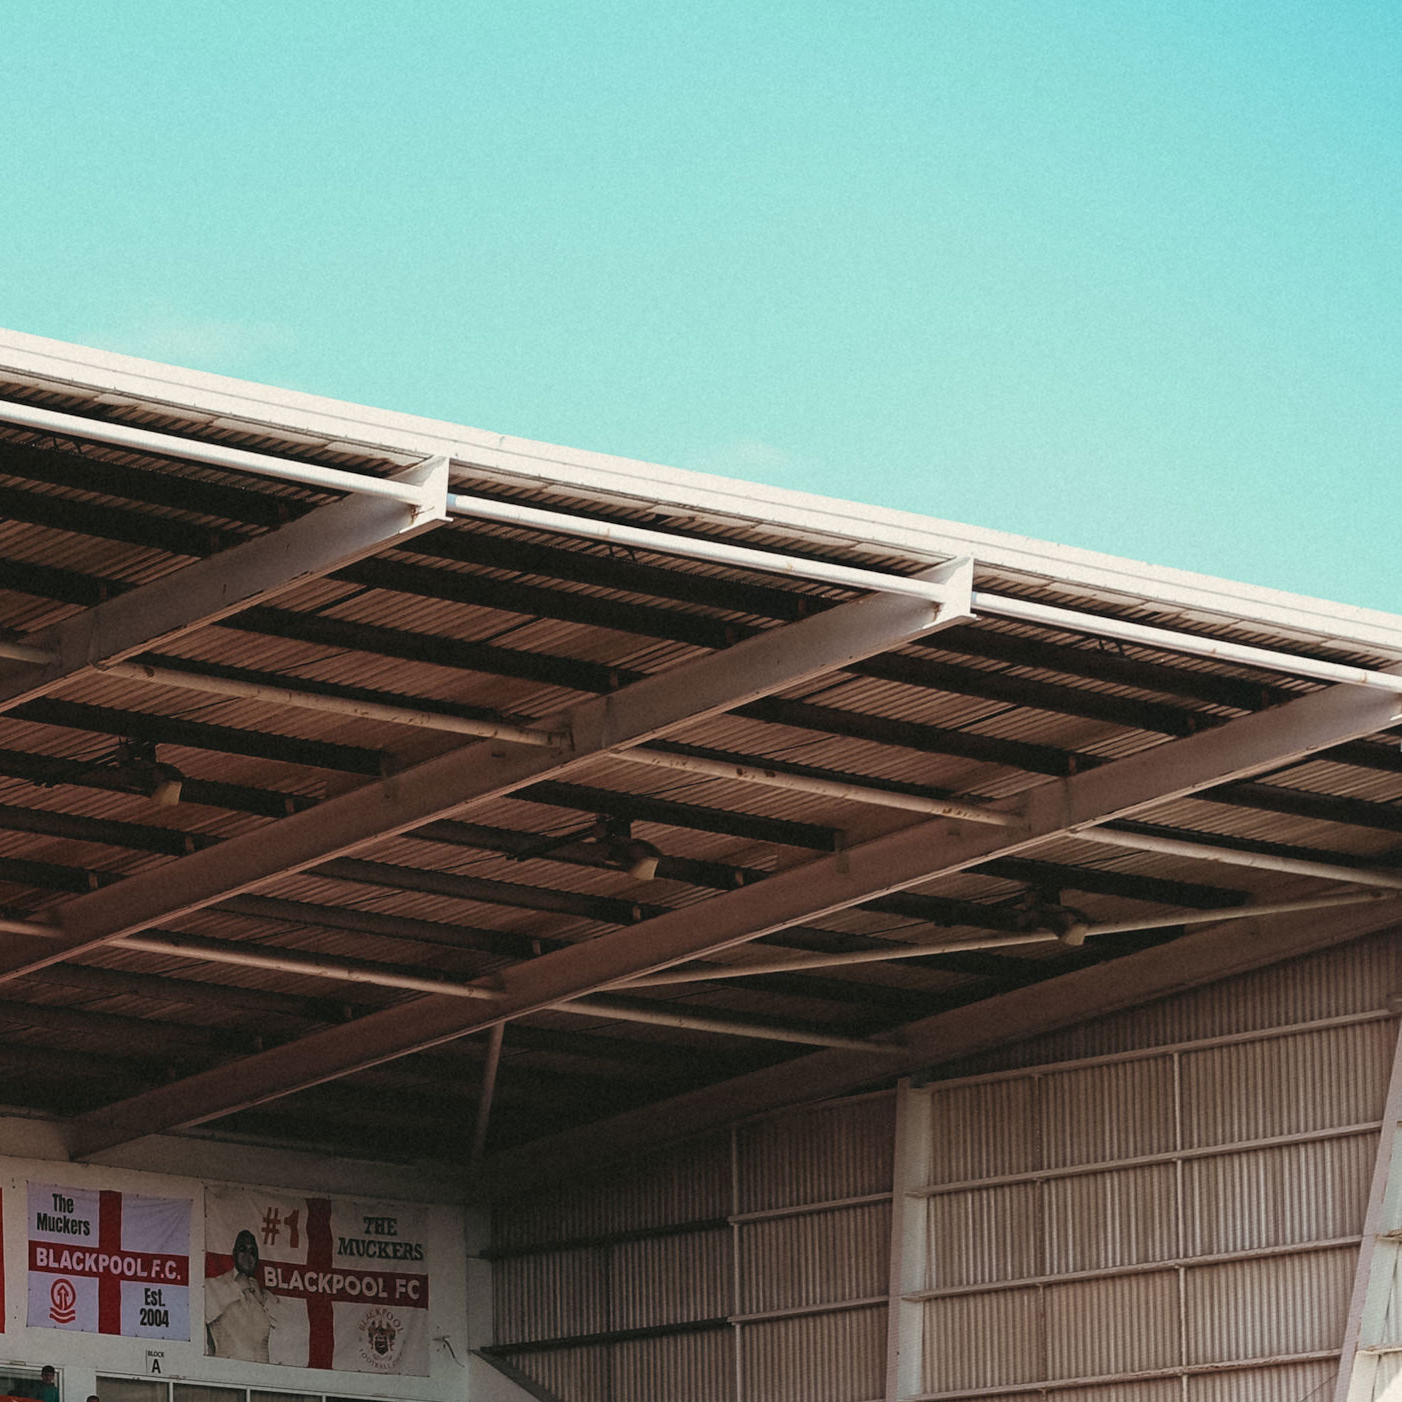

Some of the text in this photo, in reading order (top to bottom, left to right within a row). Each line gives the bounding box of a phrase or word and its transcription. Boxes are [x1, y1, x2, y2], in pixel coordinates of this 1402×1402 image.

[51, 1193, 74, 1213] The
[36, 1212, 90, 1236] Muckers
[261, 1206, 300, 1248] #1
[363, 1216, 397, 1236] THE
[337, 1237, 424, 1261] MUCKERS
[36, 1249, 181, 1279] BLACKPOOL F.C.
[264, 1266, 420, 1300] BLACKPOOL FC
[143, 1287, 166, 1307] Est.
[139, 1308, 169, 1328] 2004
[358, 1308, 404, 1331] BLACKPOOL
[147, 1350, 165, 1358] BLOCK
[151, 1358, 161, 1374] A
